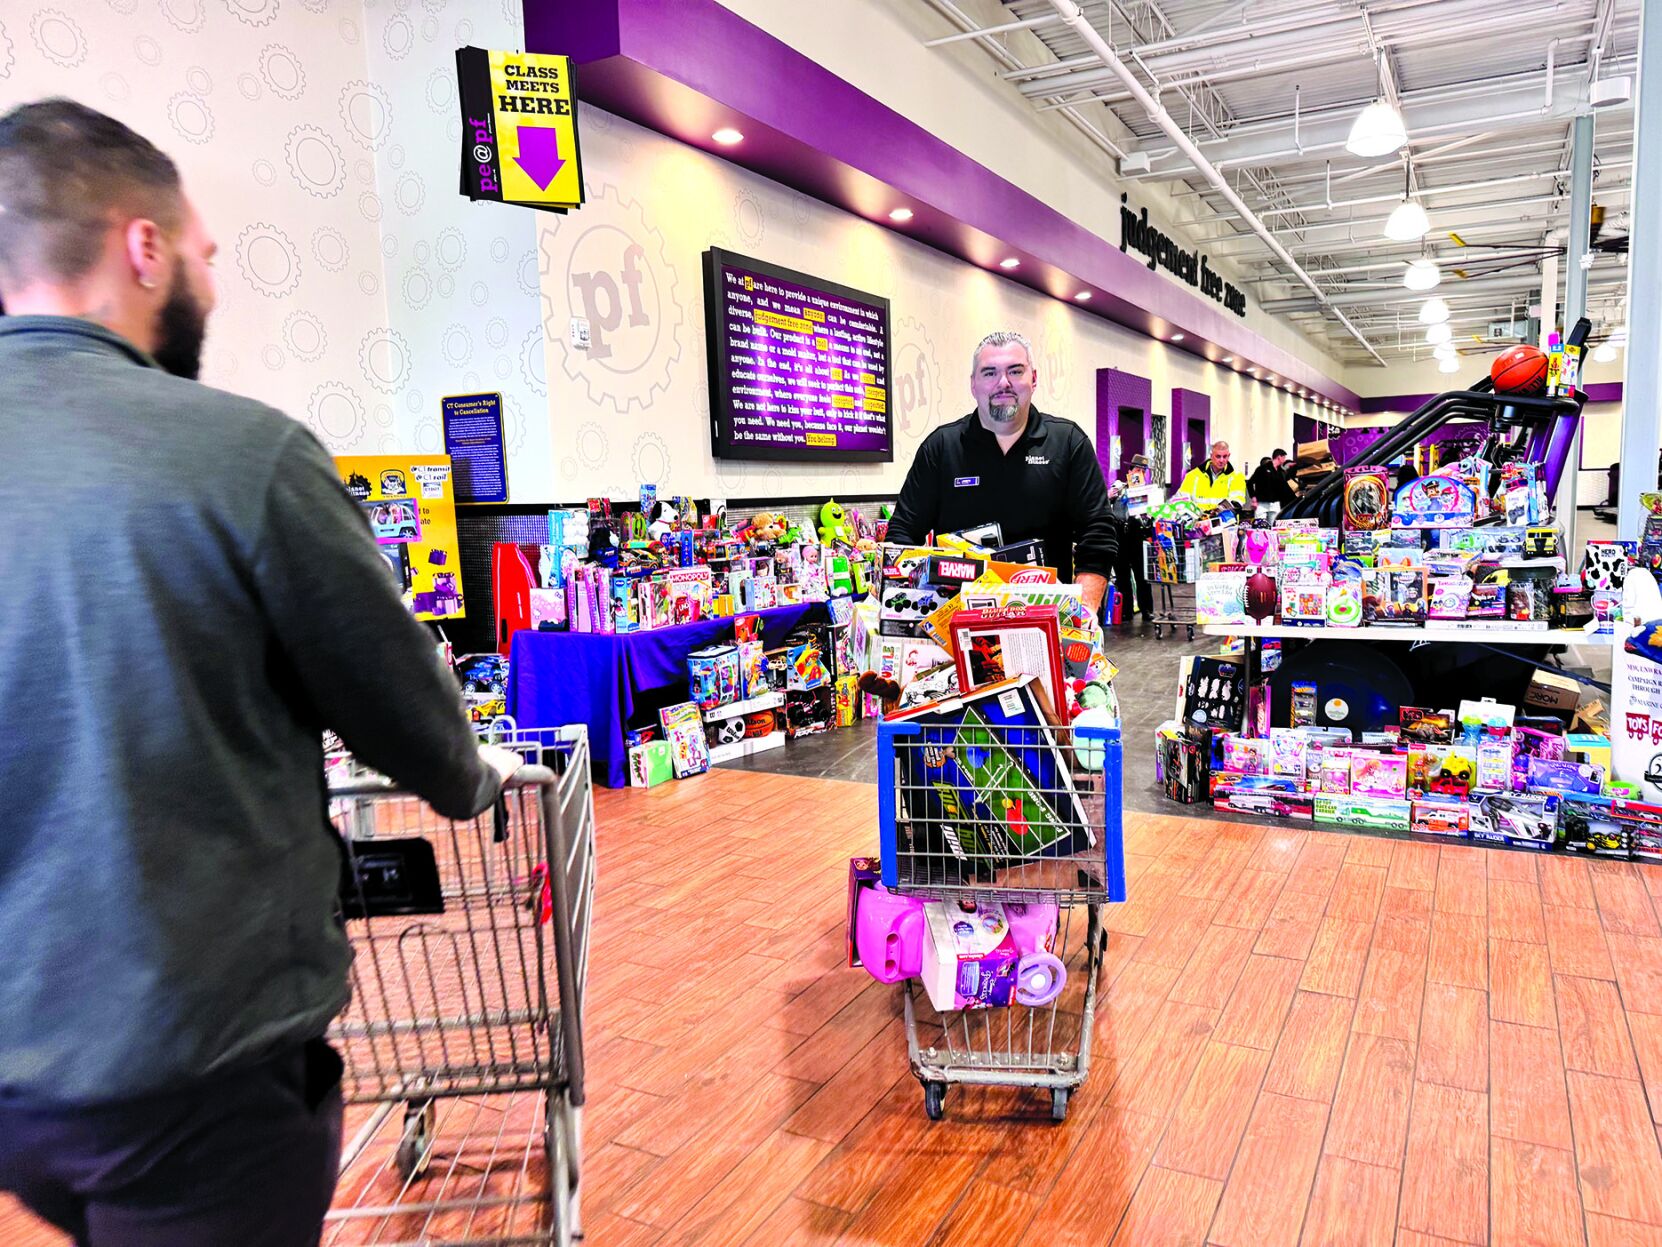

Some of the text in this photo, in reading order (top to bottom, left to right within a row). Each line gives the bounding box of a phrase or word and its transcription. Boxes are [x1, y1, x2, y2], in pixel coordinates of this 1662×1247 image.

[504, 65, 558, 79] CLASS
[506, 80, 559, 93] MEETS
[498, 96, 570, 115] HERE
[469, 118, 498, 192] pe@pf
[1120, 192, 1246, 317] judgement free zone
[726, 272, 736, 284] We
[764, 282, 777, 294] here
[785, 290, 806, 301] provide
[571, 244, 649, 360] pf
[757, 297, 769, 307] and
[729, 323, 741, 332] can
[730, 336, 749, 348] brand
[895, 352, 927, 431] pf
[733, 399, 743, 409] We
[734, 418, 745, 427] you
[744, 431, 754, 440] the
[755, 433, 771, 441] same
[772, 432, 794, 442] without
[939, 561, 976, 579] MARVEL
[671, 572, 709, 583] MONOPOLY
[1010, 570, 1050, 584] NERF
[882, 645, 894, 678] URTLE
[1628, 675, 1657, 686] CAMPAIGN
[1632, 684, 1661, 694] THROUGH
[1628, 718, 1648, 731] TOYS
